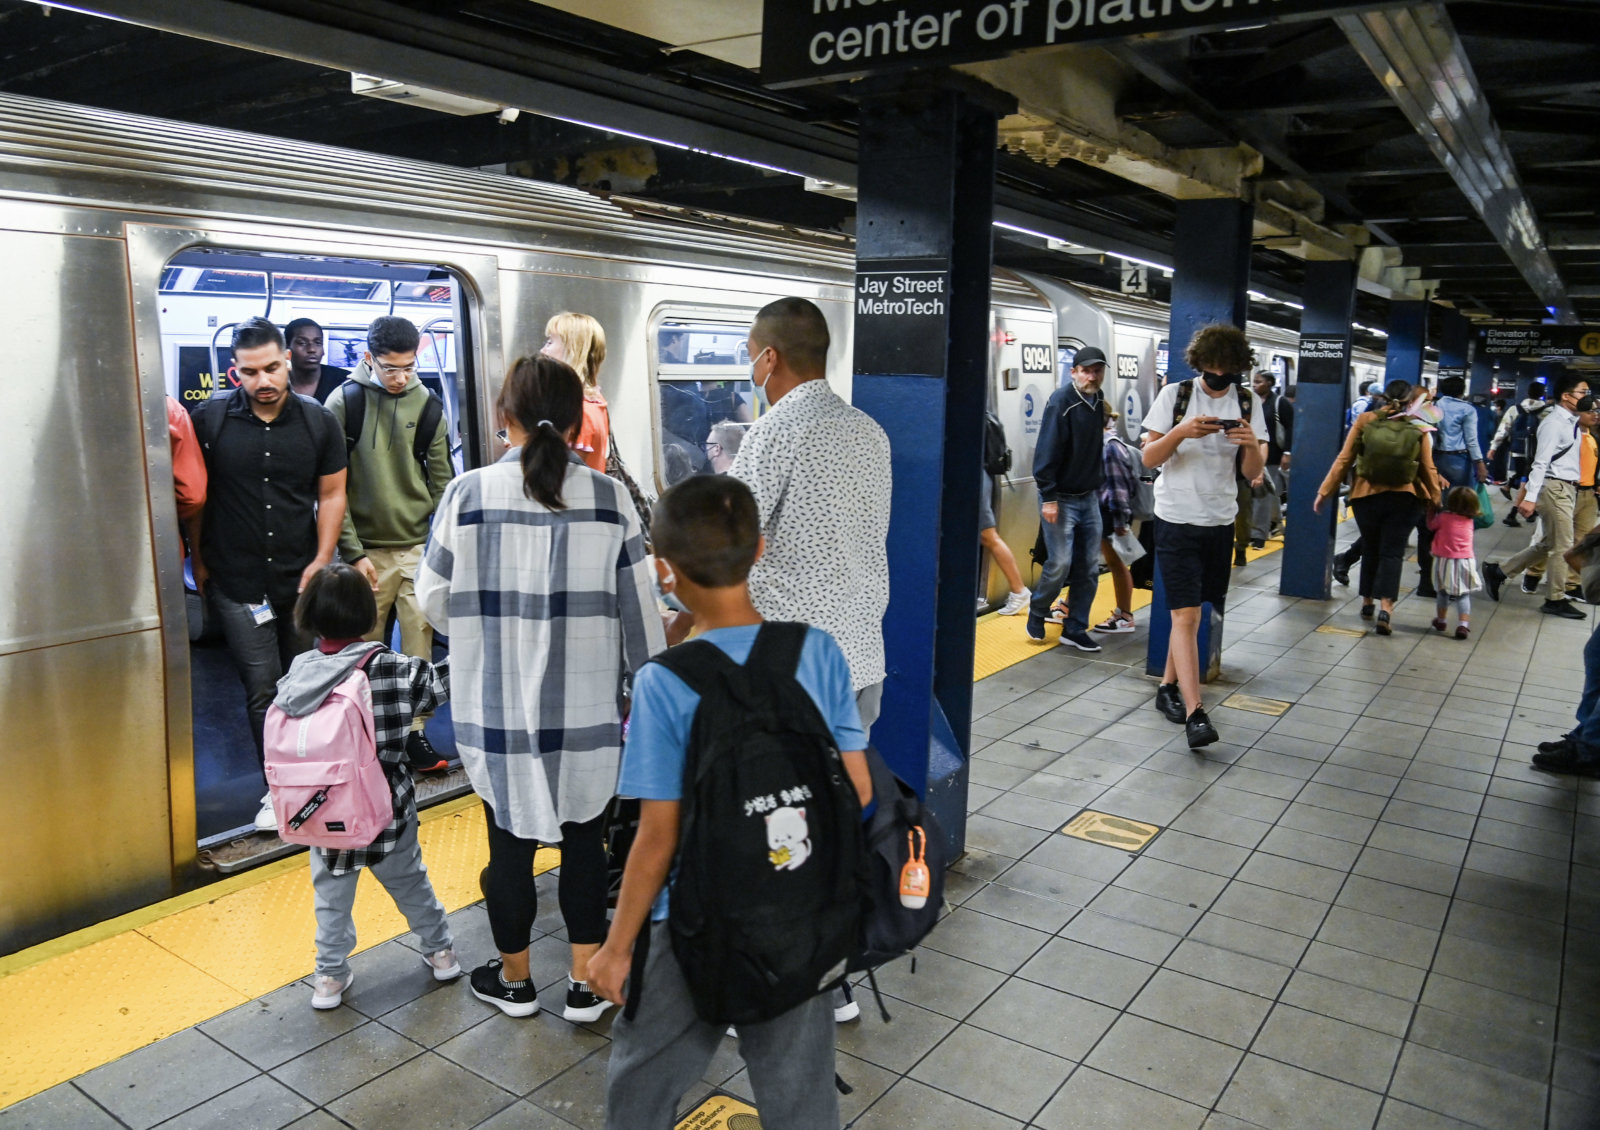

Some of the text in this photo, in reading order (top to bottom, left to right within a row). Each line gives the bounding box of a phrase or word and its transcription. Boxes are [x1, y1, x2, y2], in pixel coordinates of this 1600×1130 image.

[809, 9, 962, 65] center
[976, 0, 1029, 41] of
[858, 276, 945, 297] Jay Street
[1127, 270, 1142, 290] 4
[857, 298, 944, 315] MetroTech
[1488, 329, 1541, 338] Elevator to
[1300, 341, 1344, 350] Jay Street
[1531, 347, 1574, 355] platform
[1586, 337, 1598, 349] R
[1023, 346, 1051, 371] 9094
[1300, 350, 1344, 359] MetroTech
[1118, 356, 1138, 377] 9095
[199, 372, 227, 388] WE
[701, 1104, 726, 1125] distance
